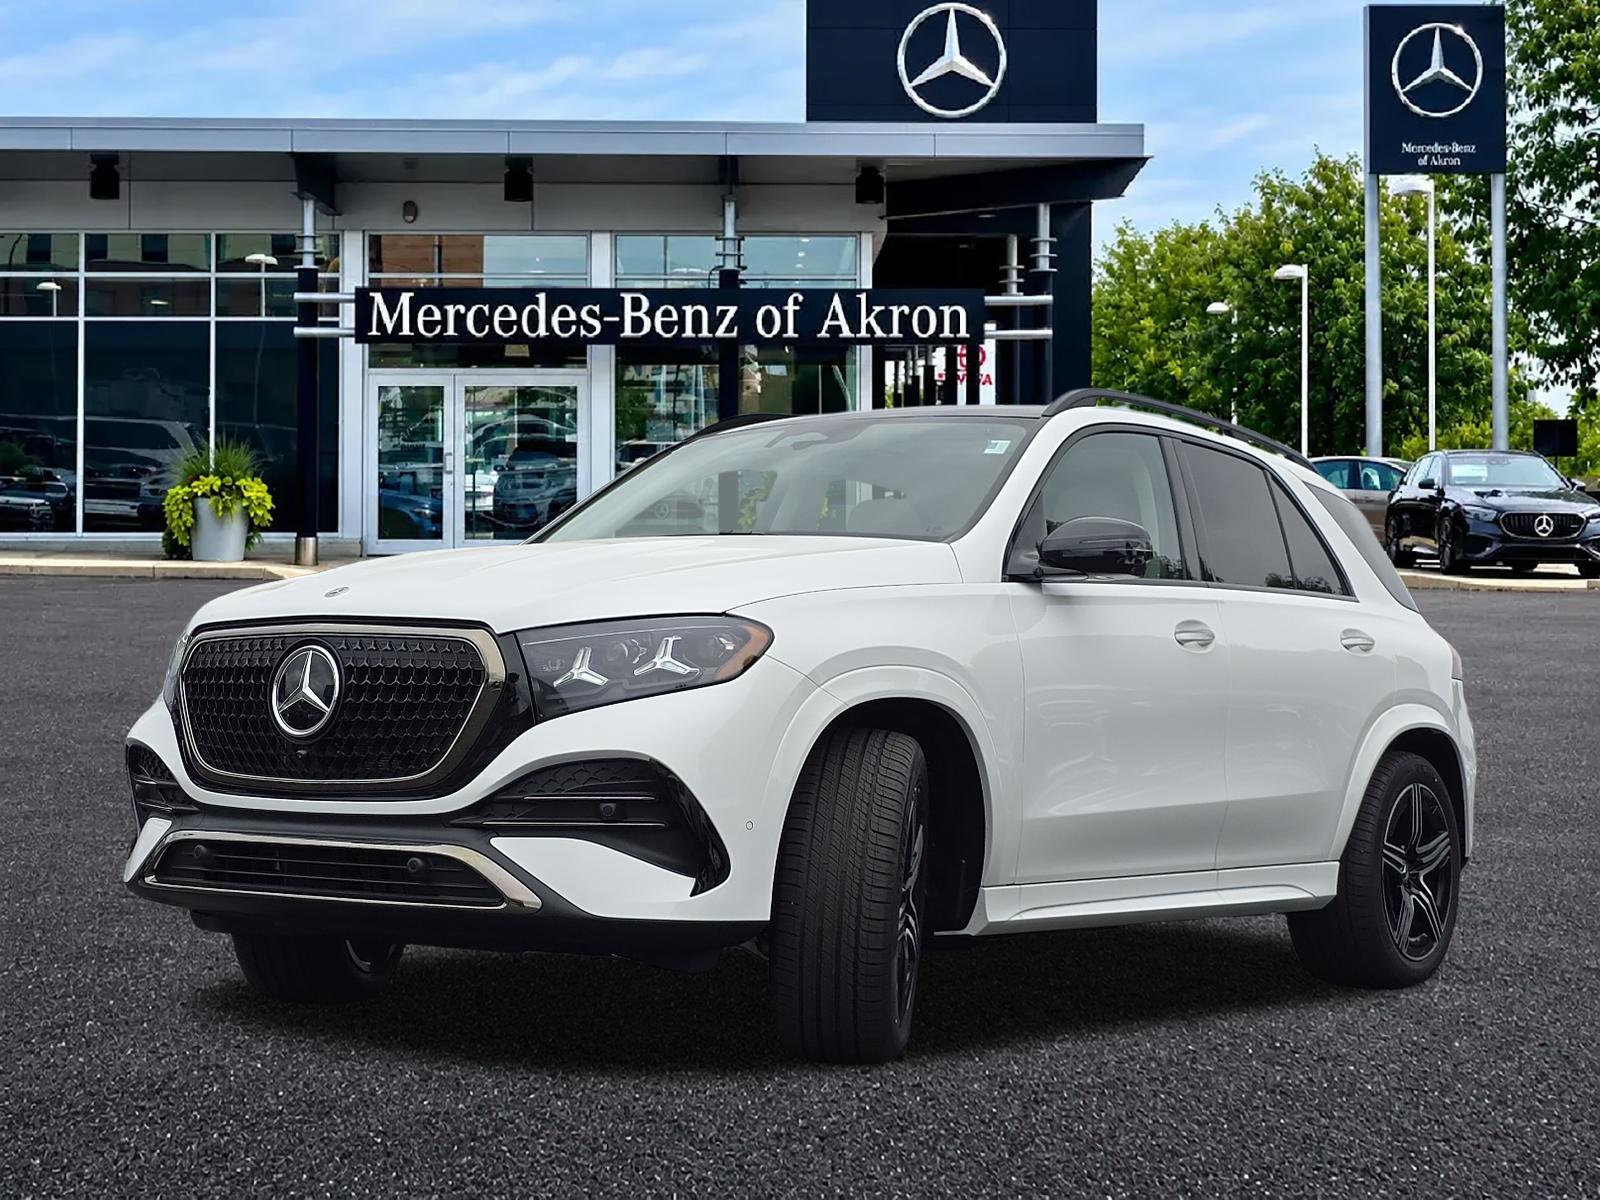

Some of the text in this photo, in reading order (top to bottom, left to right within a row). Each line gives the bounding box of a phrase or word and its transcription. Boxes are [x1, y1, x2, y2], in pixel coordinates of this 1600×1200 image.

[1401, 142, 1477, 154] Mercedes-Benz
[1417, 154, 1461, 166] of Akron
[367, 291, 971, 338] Mercedes-Benz of Akron
